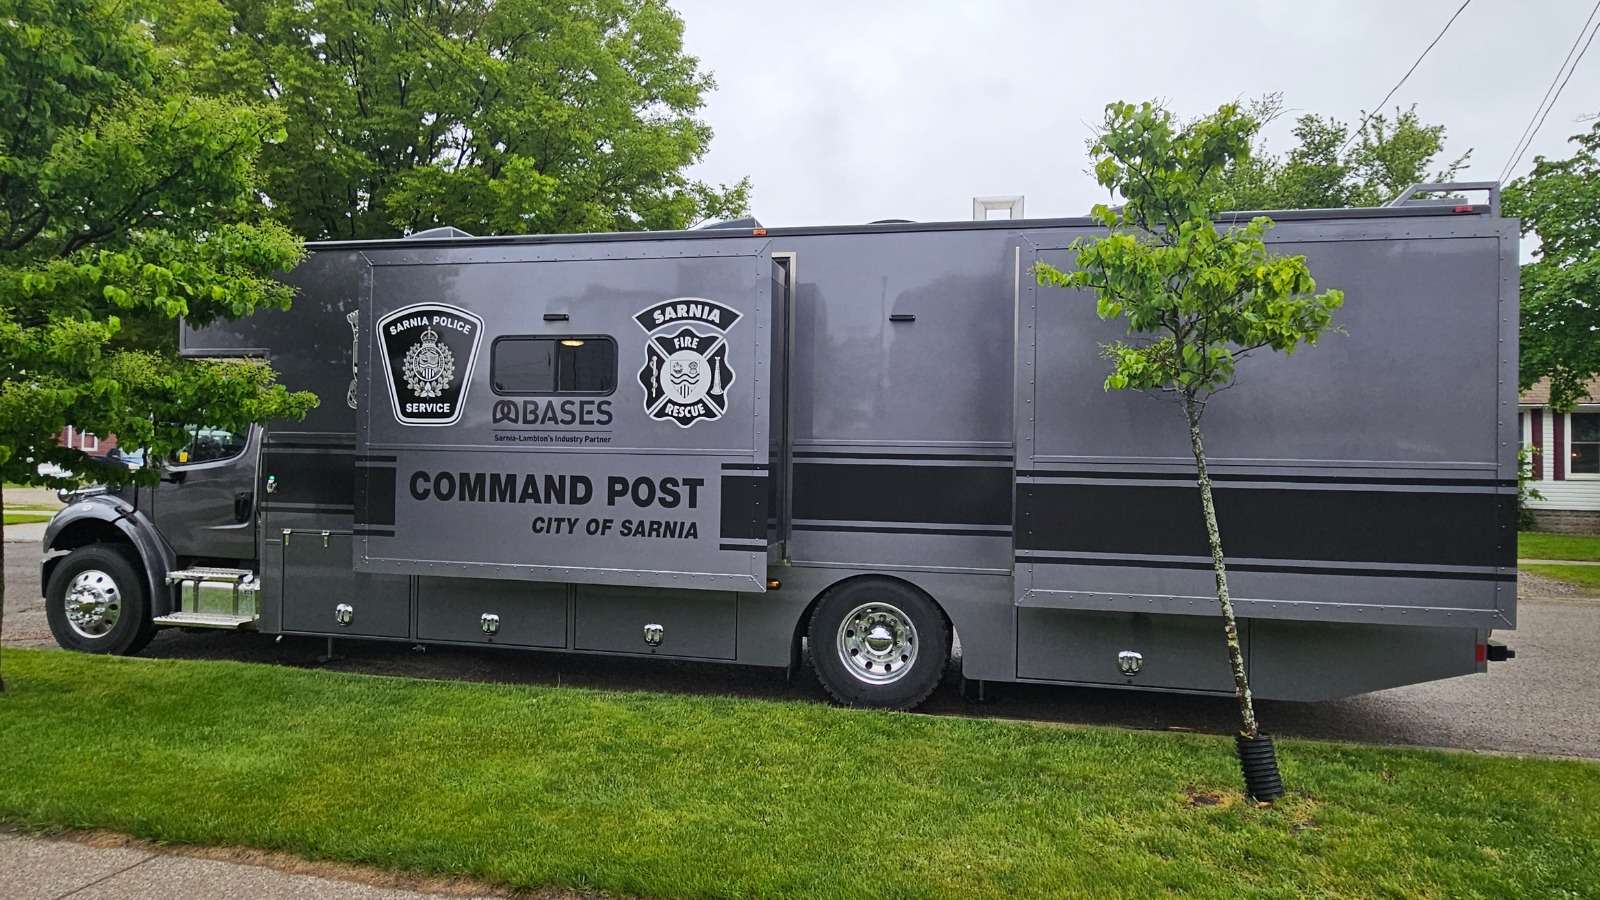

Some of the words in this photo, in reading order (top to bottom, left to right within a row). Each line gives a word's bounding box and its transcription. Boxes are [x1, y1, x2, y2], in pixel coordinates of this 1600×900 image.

[653, 303, 721, 325] SARNIA
[389, 316, 429, 335] SARNIA
[433, 316, 472, 335] POLICE
[673, 336, 700, 349] FIRE
[406, 403, 451, 413] SERVICE
[522, 399, 613, 425] BASES
[665, 402, 706, 418] RESCUE
[494, 433, 554, 442] Sarnia-Lambton's
[555, 434, 583, 444] Industry
[584, 435, 612, 443] Partner
[409, 470, 593, 506] COMMAND
[607, 475, 705, 509] POST
[531, 516, 580, 535] CITY
[585, 517, 614, 537] OF
[619, 519, 699, 540] SARNIA
